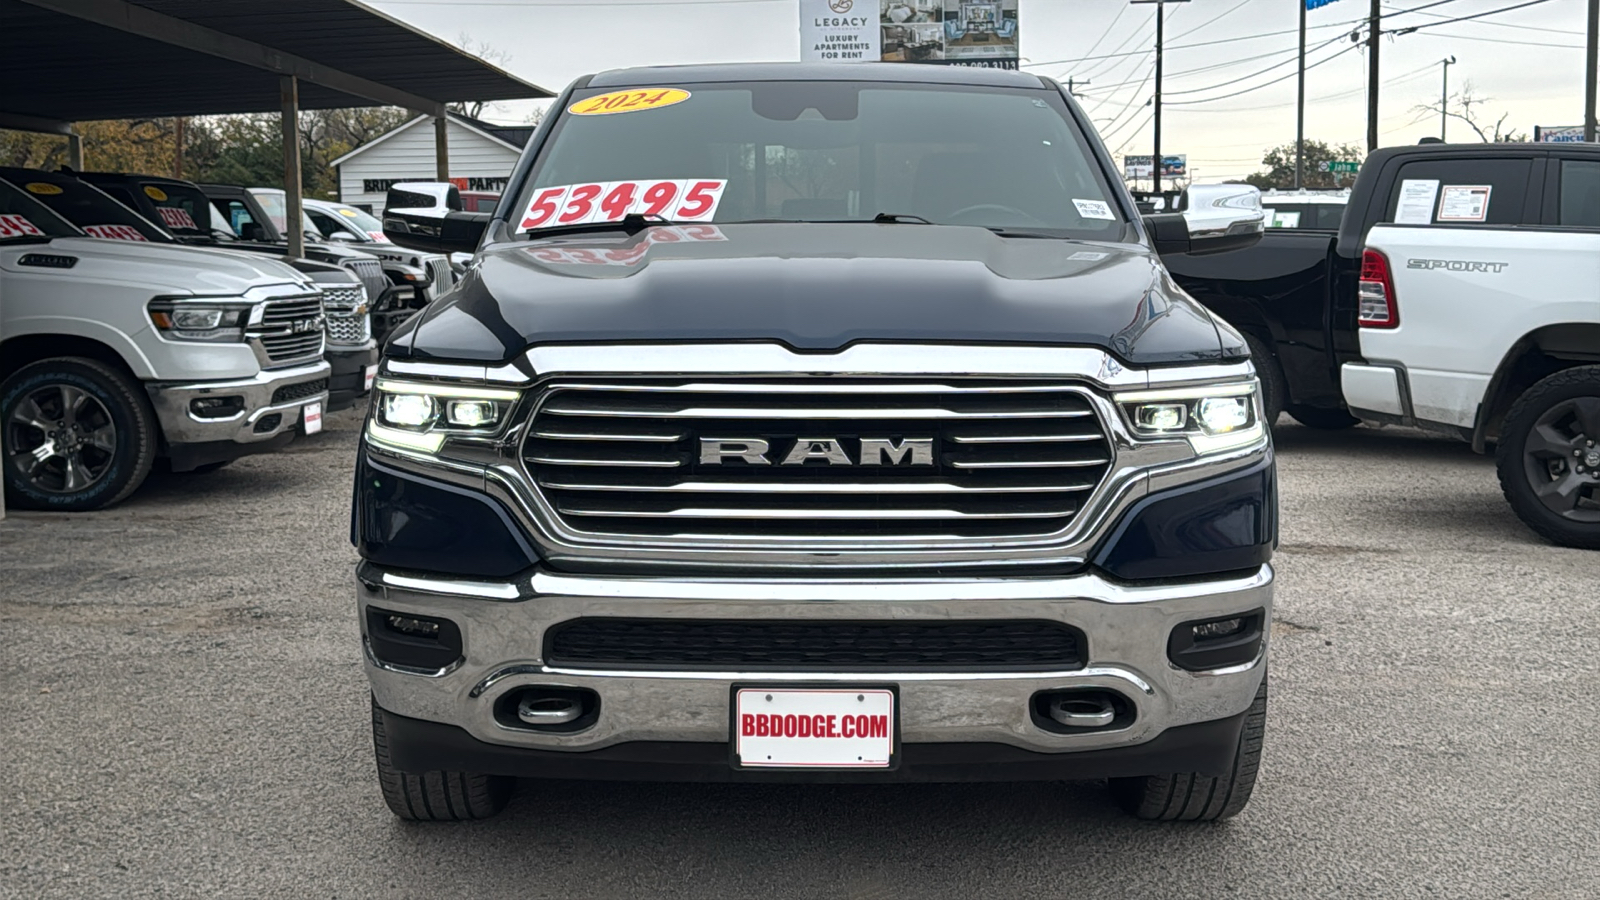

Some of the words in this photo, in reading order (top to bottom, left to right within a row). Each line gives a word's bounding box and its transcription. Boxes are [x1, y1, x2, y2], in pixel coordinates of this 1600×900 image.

[814, 17, 868, 27] LEGACY
[824, 34, 859, 42] LUXURY
[583, 90, 670, 113] 2024
[1544, 133, 1586, 142] Cancu
[520, 181, 722, 229] 53495
[1406, 258, 1509, 273] SPORT
[700, 437, 934, 465] RAM
[742, 713, 888, 738] BBDODGE.COM
